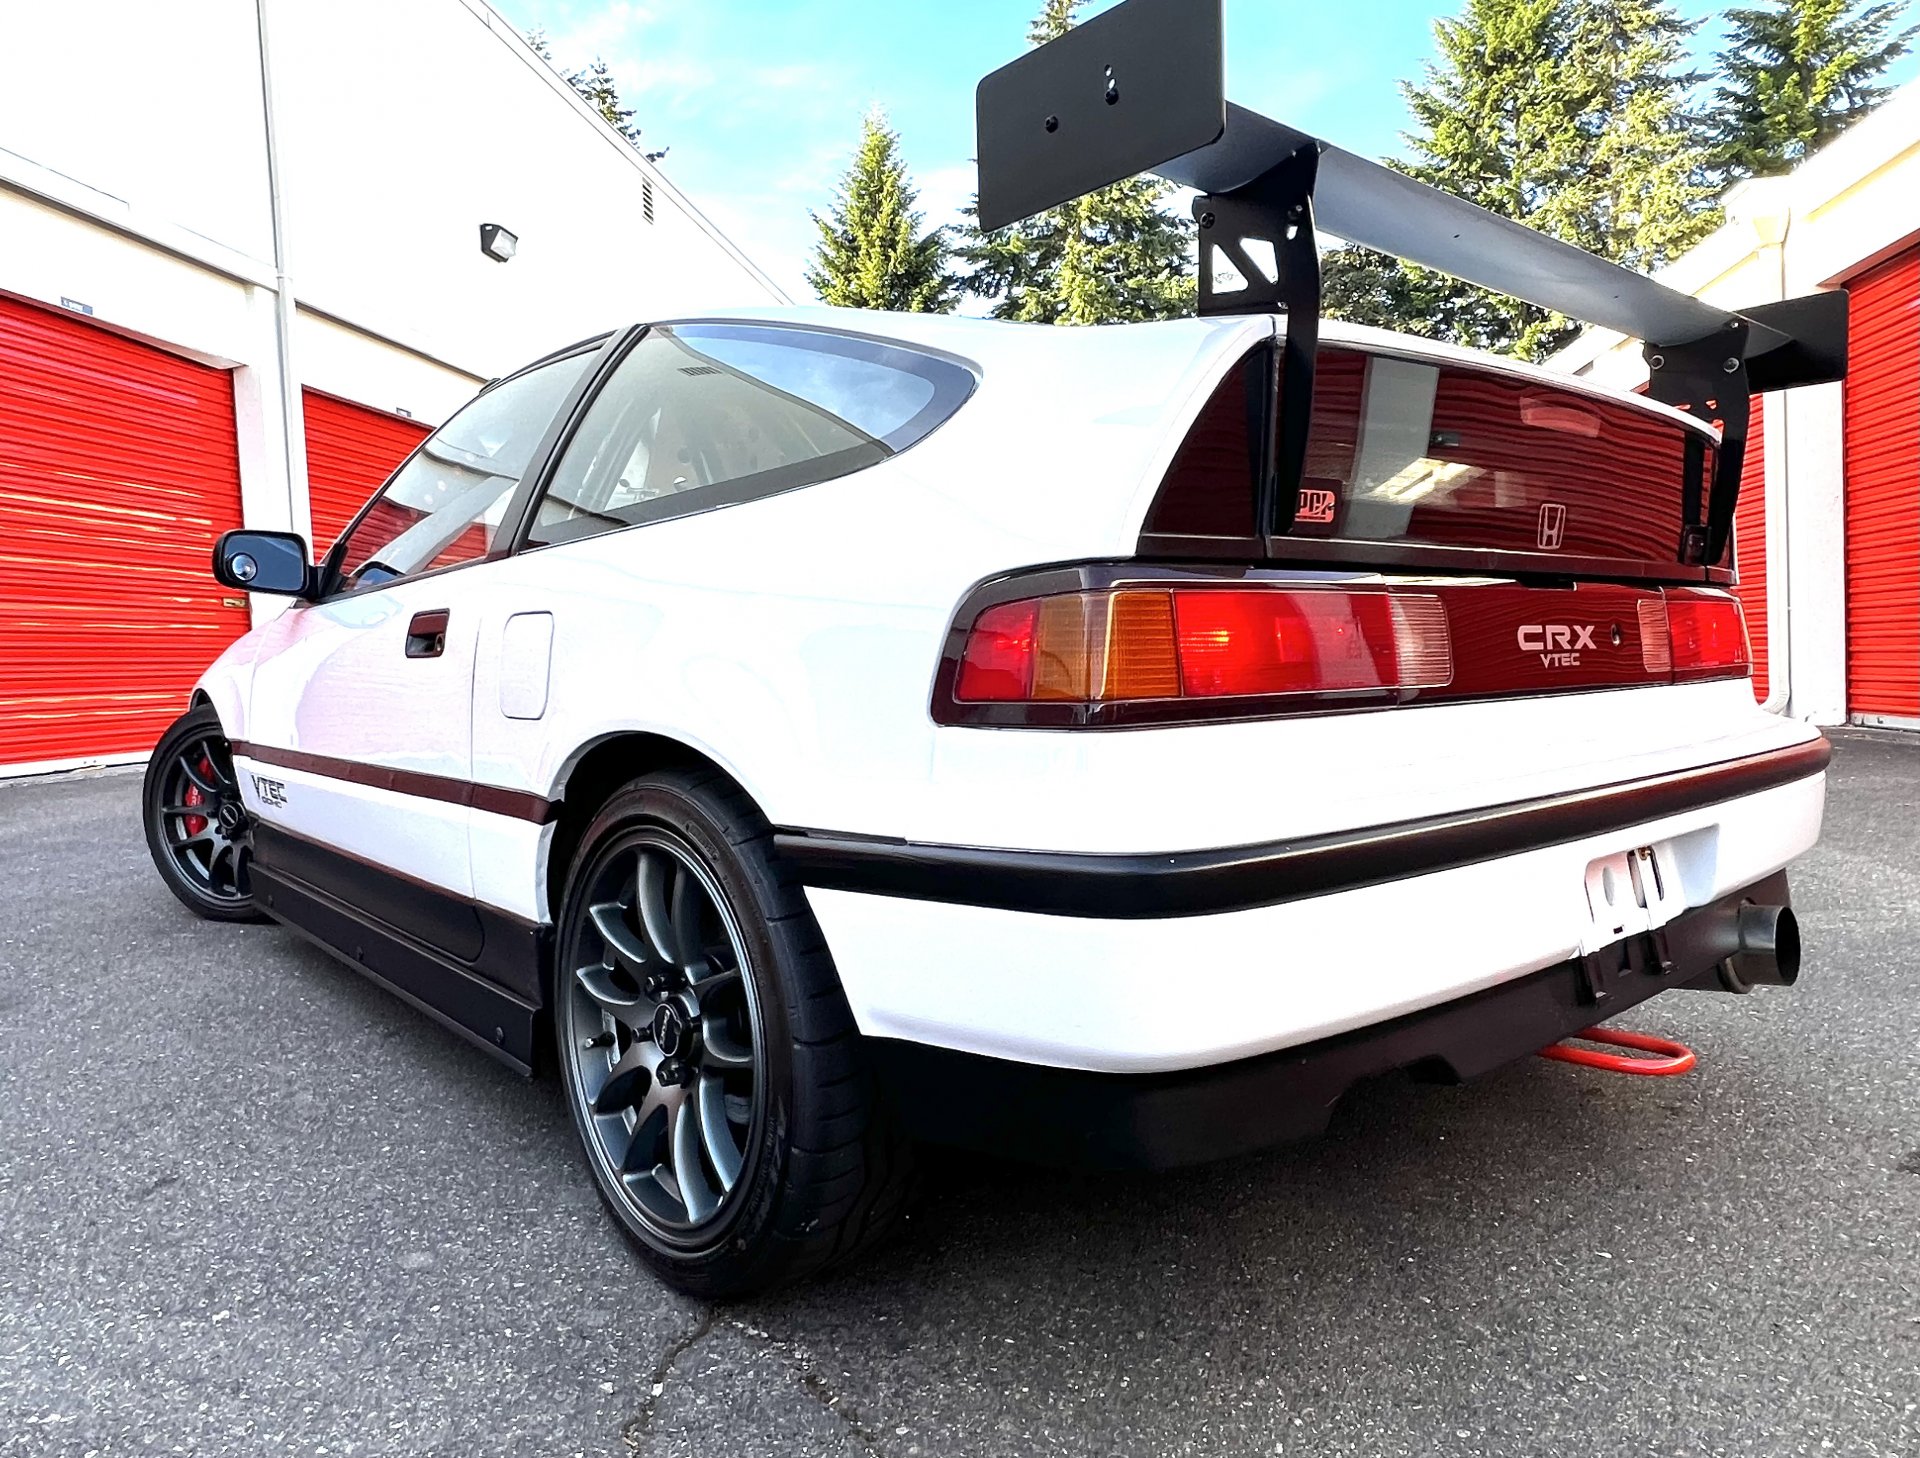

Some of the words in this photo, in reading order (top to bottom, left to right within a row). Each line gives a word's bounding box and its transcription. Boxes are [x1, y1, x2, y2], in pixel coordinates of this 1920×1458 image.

[1517, 625, 1597, 651] CRX
[1540, 652, 1580, 669] VTEC
[251, 774, 288, 803] VTEC
